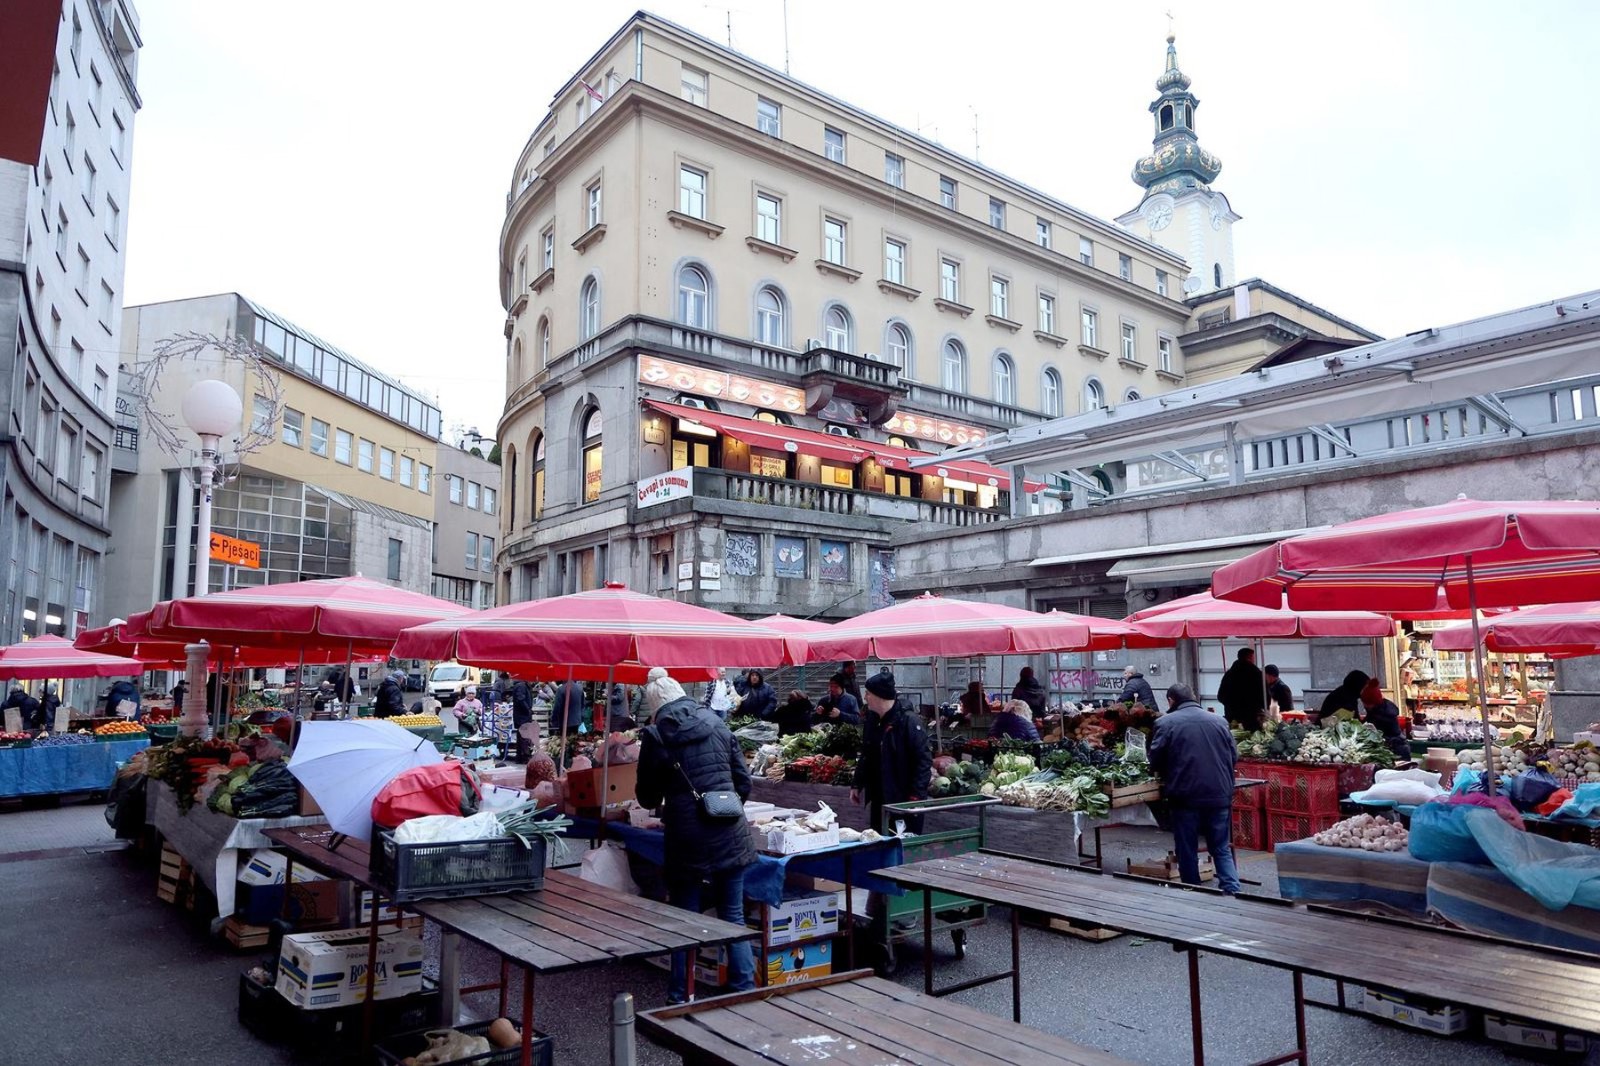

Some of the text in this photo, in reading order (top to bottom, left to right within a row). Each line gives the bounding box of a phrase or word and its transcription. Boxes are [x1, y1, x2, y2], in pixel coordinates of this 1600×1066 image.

[222, 539, 258, 562] Pješaci
[794, 910, 818, 928] BONITA
[349, 960, 387, 984] BONTA
